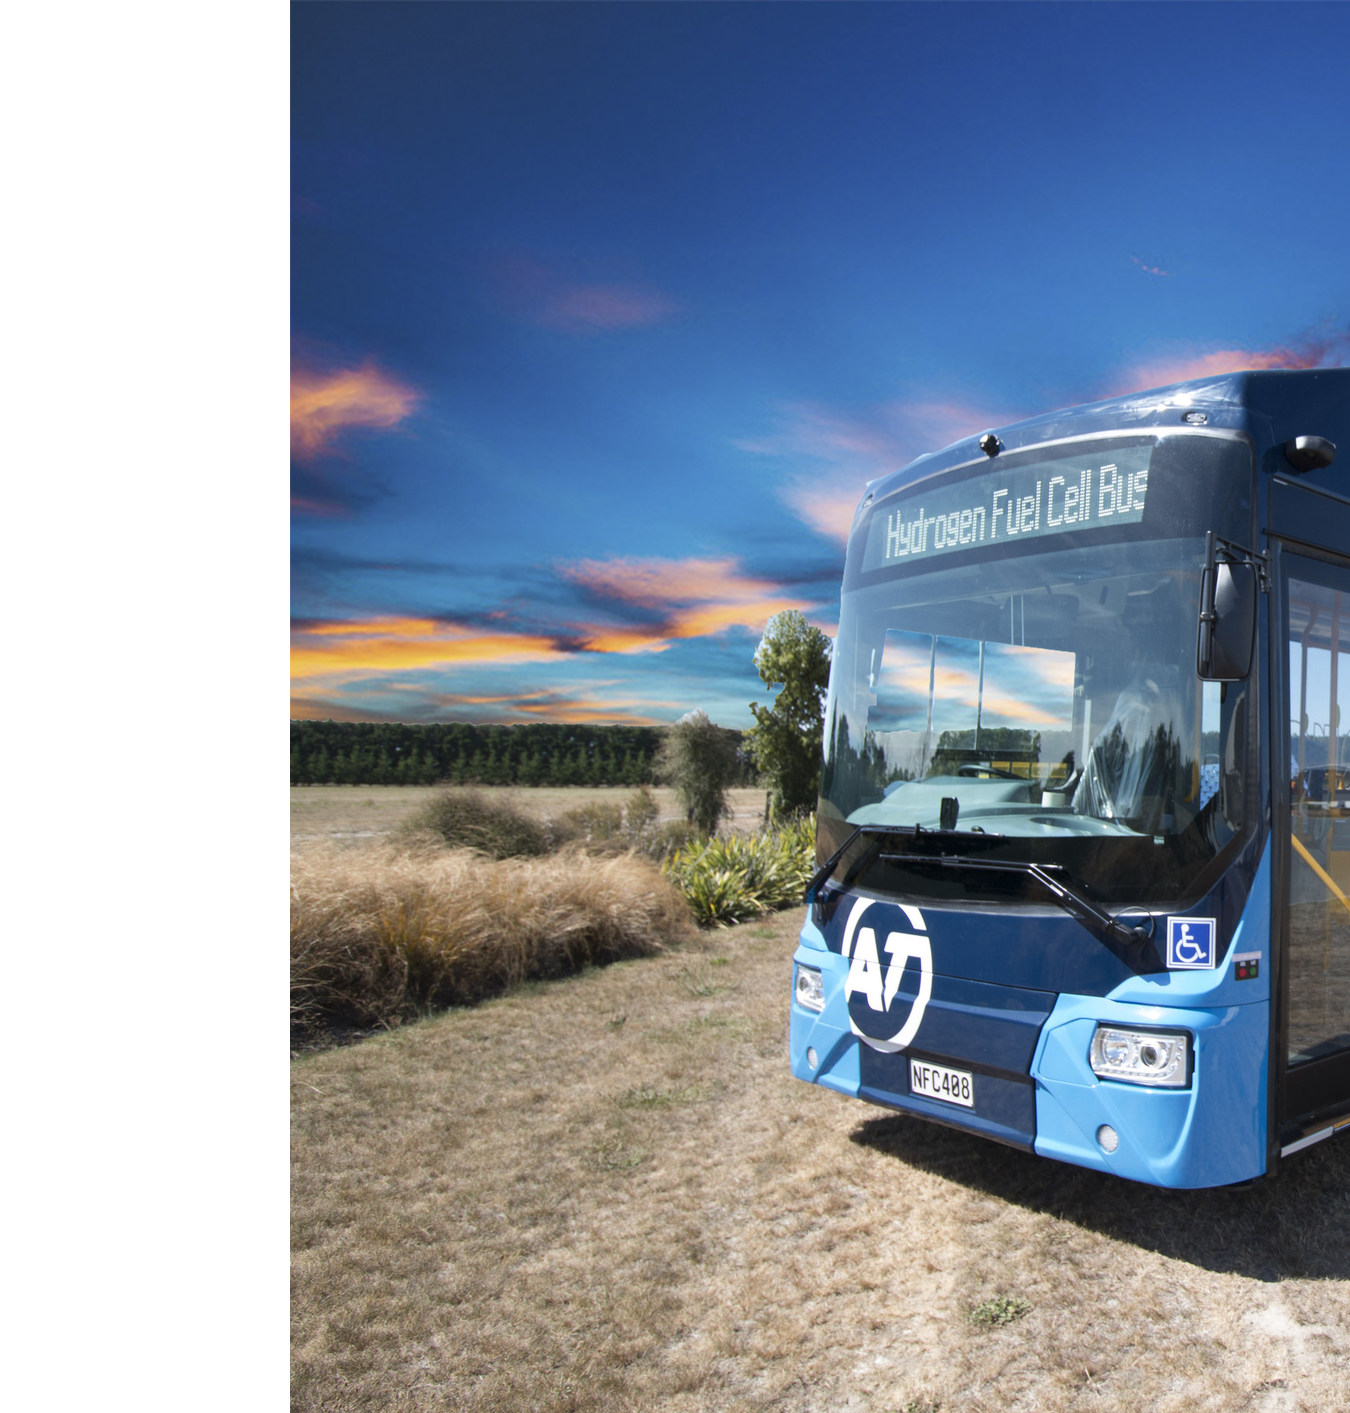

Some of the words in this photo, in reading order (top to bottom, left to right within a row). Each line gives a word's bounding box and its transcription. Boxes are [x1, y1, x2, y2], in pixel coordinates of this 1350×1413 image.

[886, 508, 986, 559] Hydrogen
[991, 480, 1042, 538] Fuel
[1047, 469, 1091, 527] Cell
[1098, 464, 1148, 517] Bus
[845, 927, 929, 1013] AT
[913, 1064, 970, 1101] NFC408
